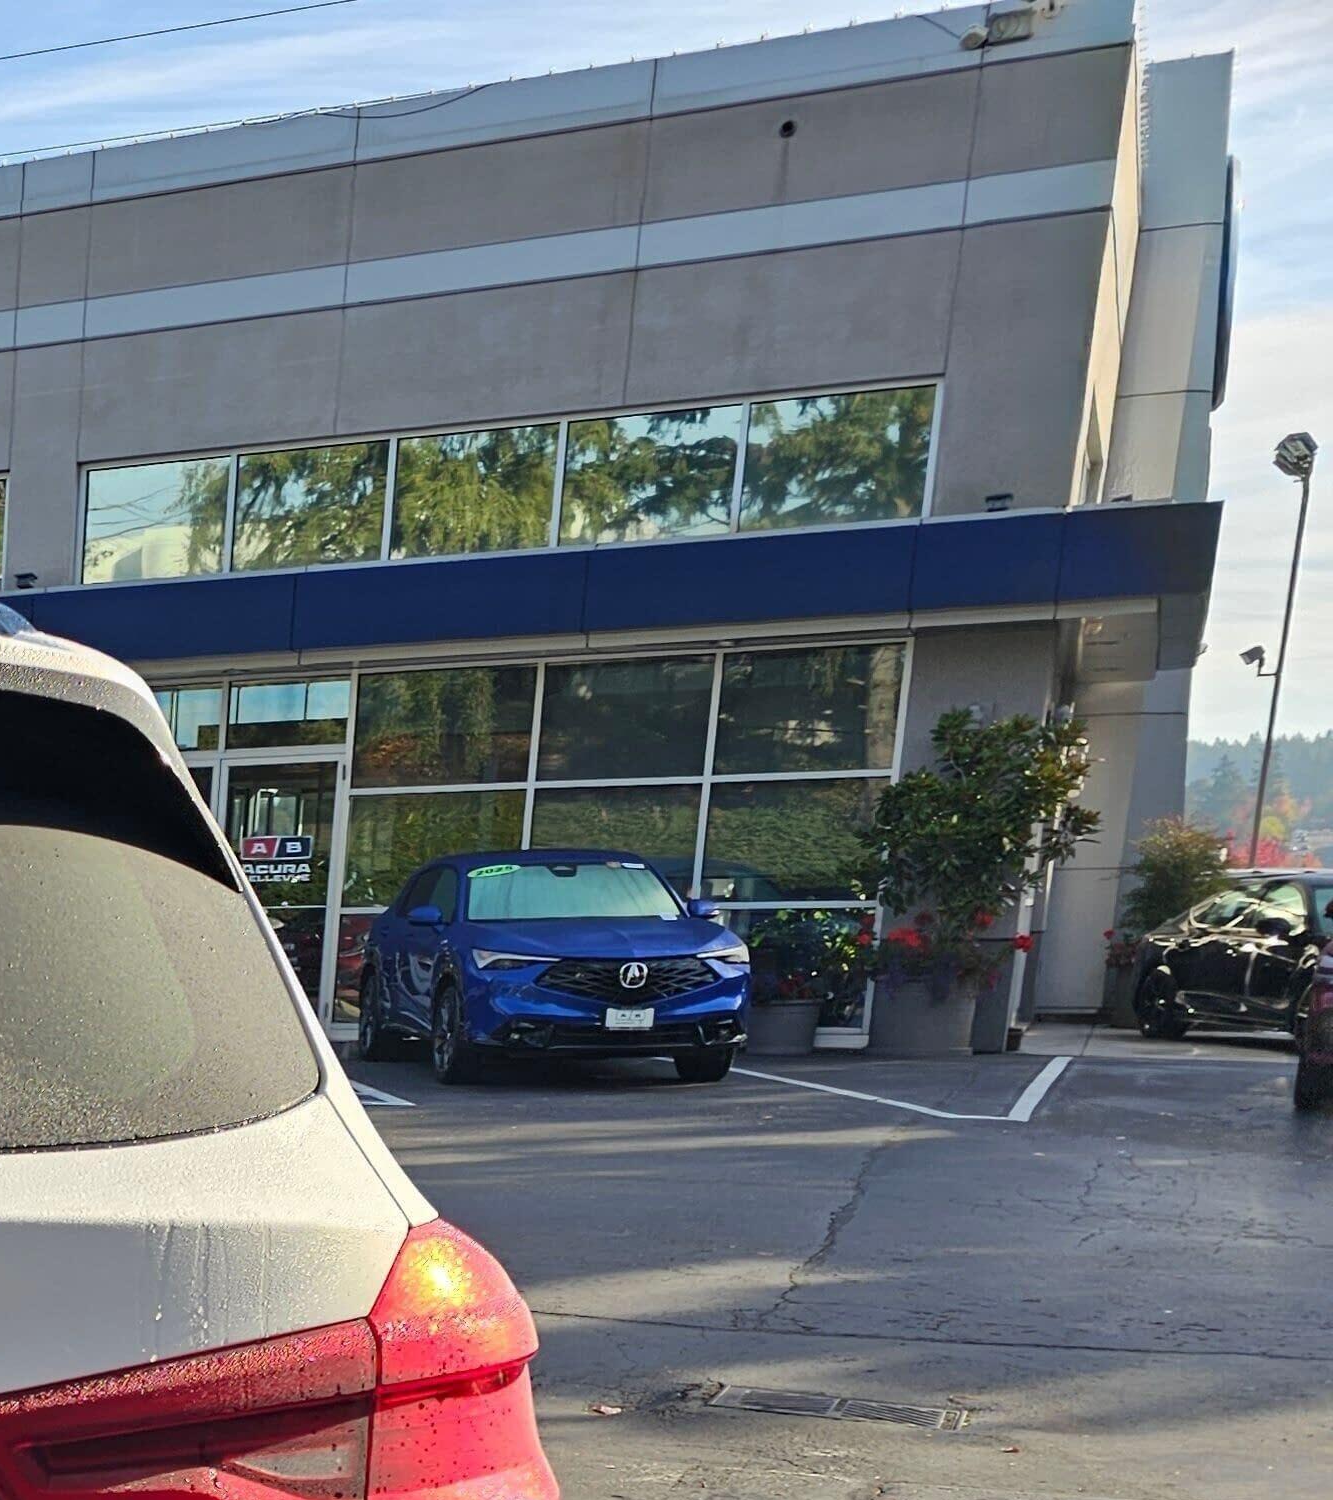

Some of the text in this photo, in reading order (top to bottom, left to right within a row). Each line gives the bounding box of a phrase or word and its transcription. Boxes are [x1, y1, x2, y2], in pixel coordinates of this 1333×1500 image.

[251, 842, 302, 854] A B
[243, 863, 311, 874] ACURA
